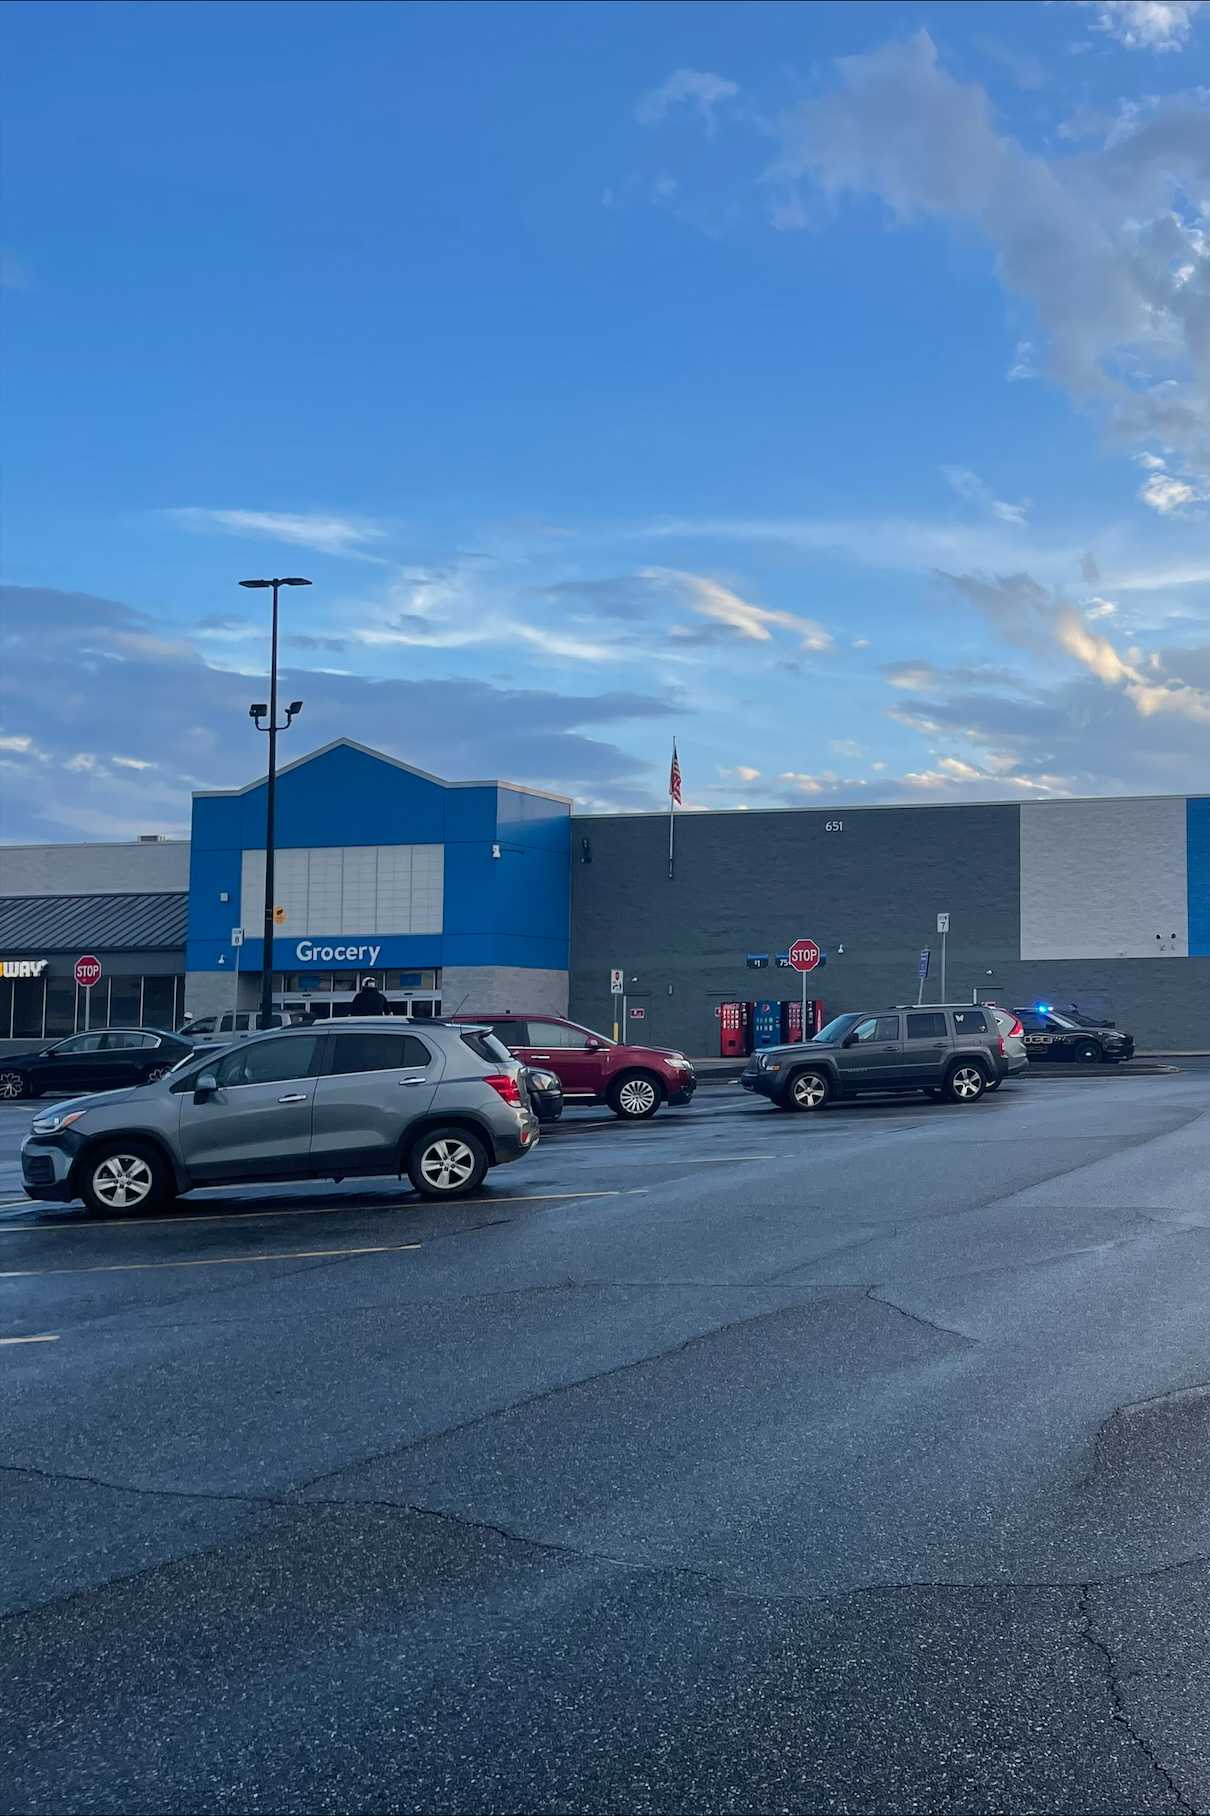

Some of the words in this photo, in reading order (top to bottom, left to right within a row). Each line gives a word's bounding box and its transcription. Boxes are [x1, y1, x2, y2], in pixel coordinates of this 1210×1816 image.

[825, 820, 843, 831] 651
[296, 941, 381, 967] Grocery
[791, 949, 818, 962] STOP
[0, 959, 48, 977] WAY
[76, 965, 99, 977] STOP
